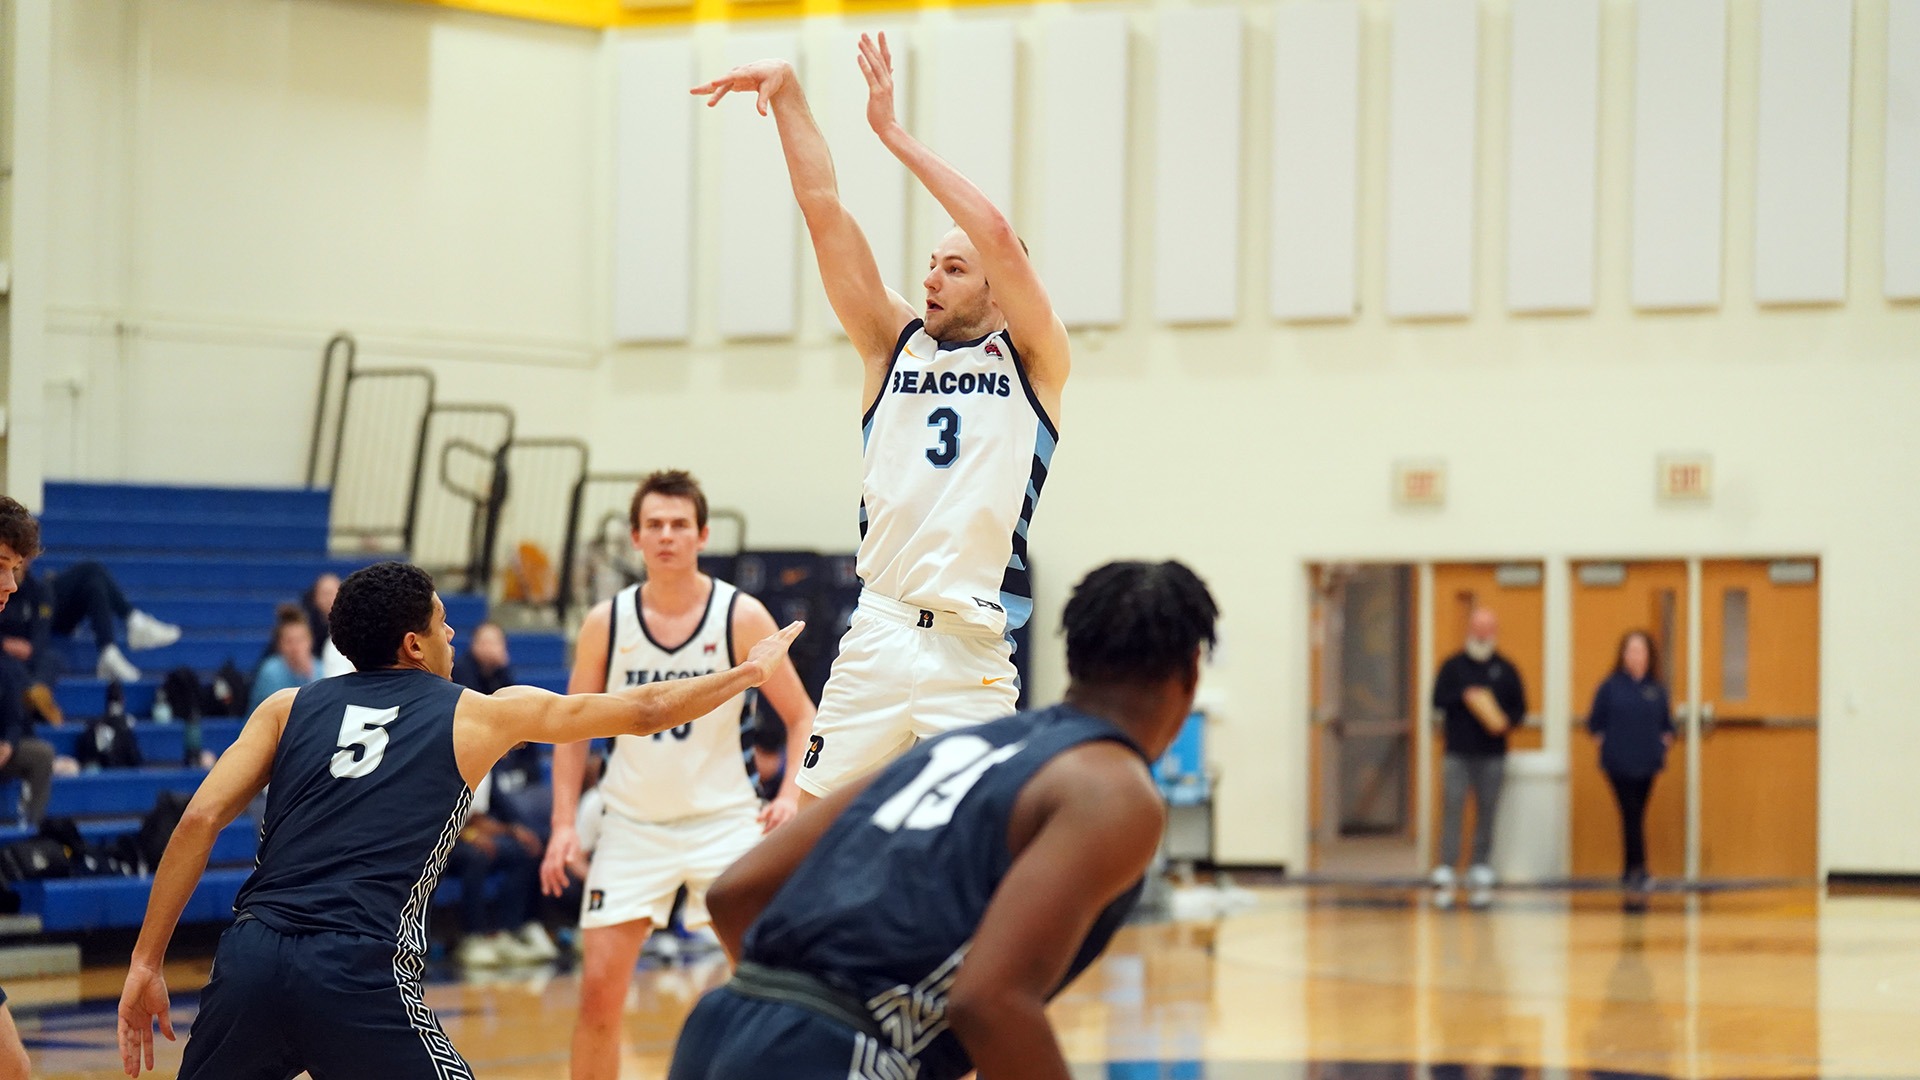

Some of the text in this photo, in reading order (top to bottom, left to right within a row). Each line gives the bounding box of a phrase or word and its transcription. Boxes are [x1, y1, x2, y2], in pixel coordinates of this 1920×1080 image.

[892, 370, 1011, 398] BEACONS
[925, 406, 962, 469] 3
[917, 610, 934, 628] B
[329, 704, 400, 779] 5
